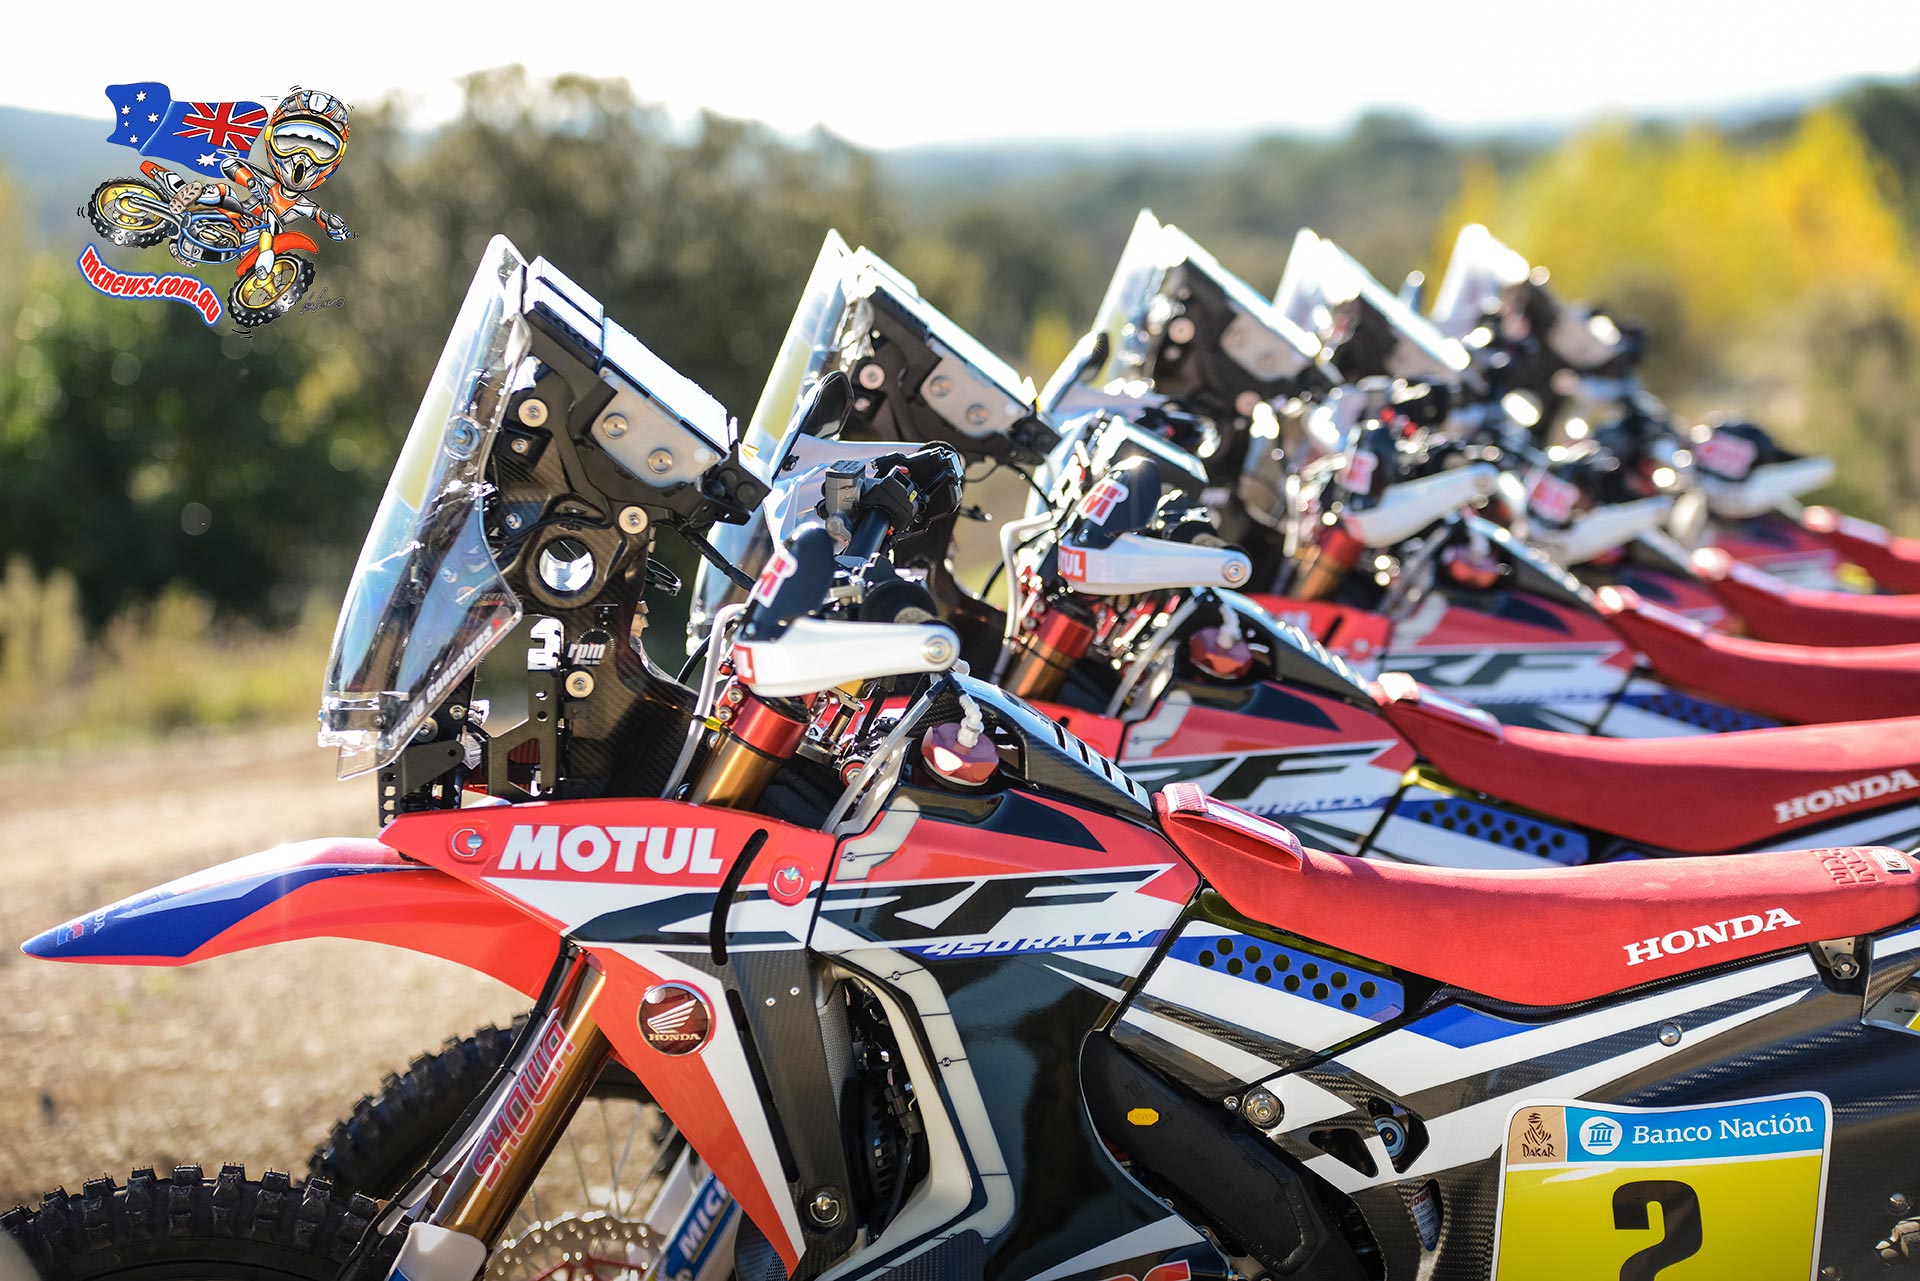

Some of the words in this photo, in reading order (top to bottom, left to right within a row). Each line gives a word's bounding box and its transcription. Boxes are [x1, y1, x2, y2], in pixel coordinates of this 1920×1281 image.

[567, 643, 606, 665] rpm
[1773, 768, 1920, 824] HONDA
[497, 824, 724, 875] MOTUL
[1623, 907, 1801, 967] HONDA
[648, 1033, 702, 1042] HONDA
[472, 1019, 576, 1192] SHOWA
[1632, 1125, 1712, 1145] Banco
[1718, 1112, 1814, 1141] Nación
[1521, 1143, 1557, 1158] DAKAR
[1612, 1179, 1703, 1281] 2
